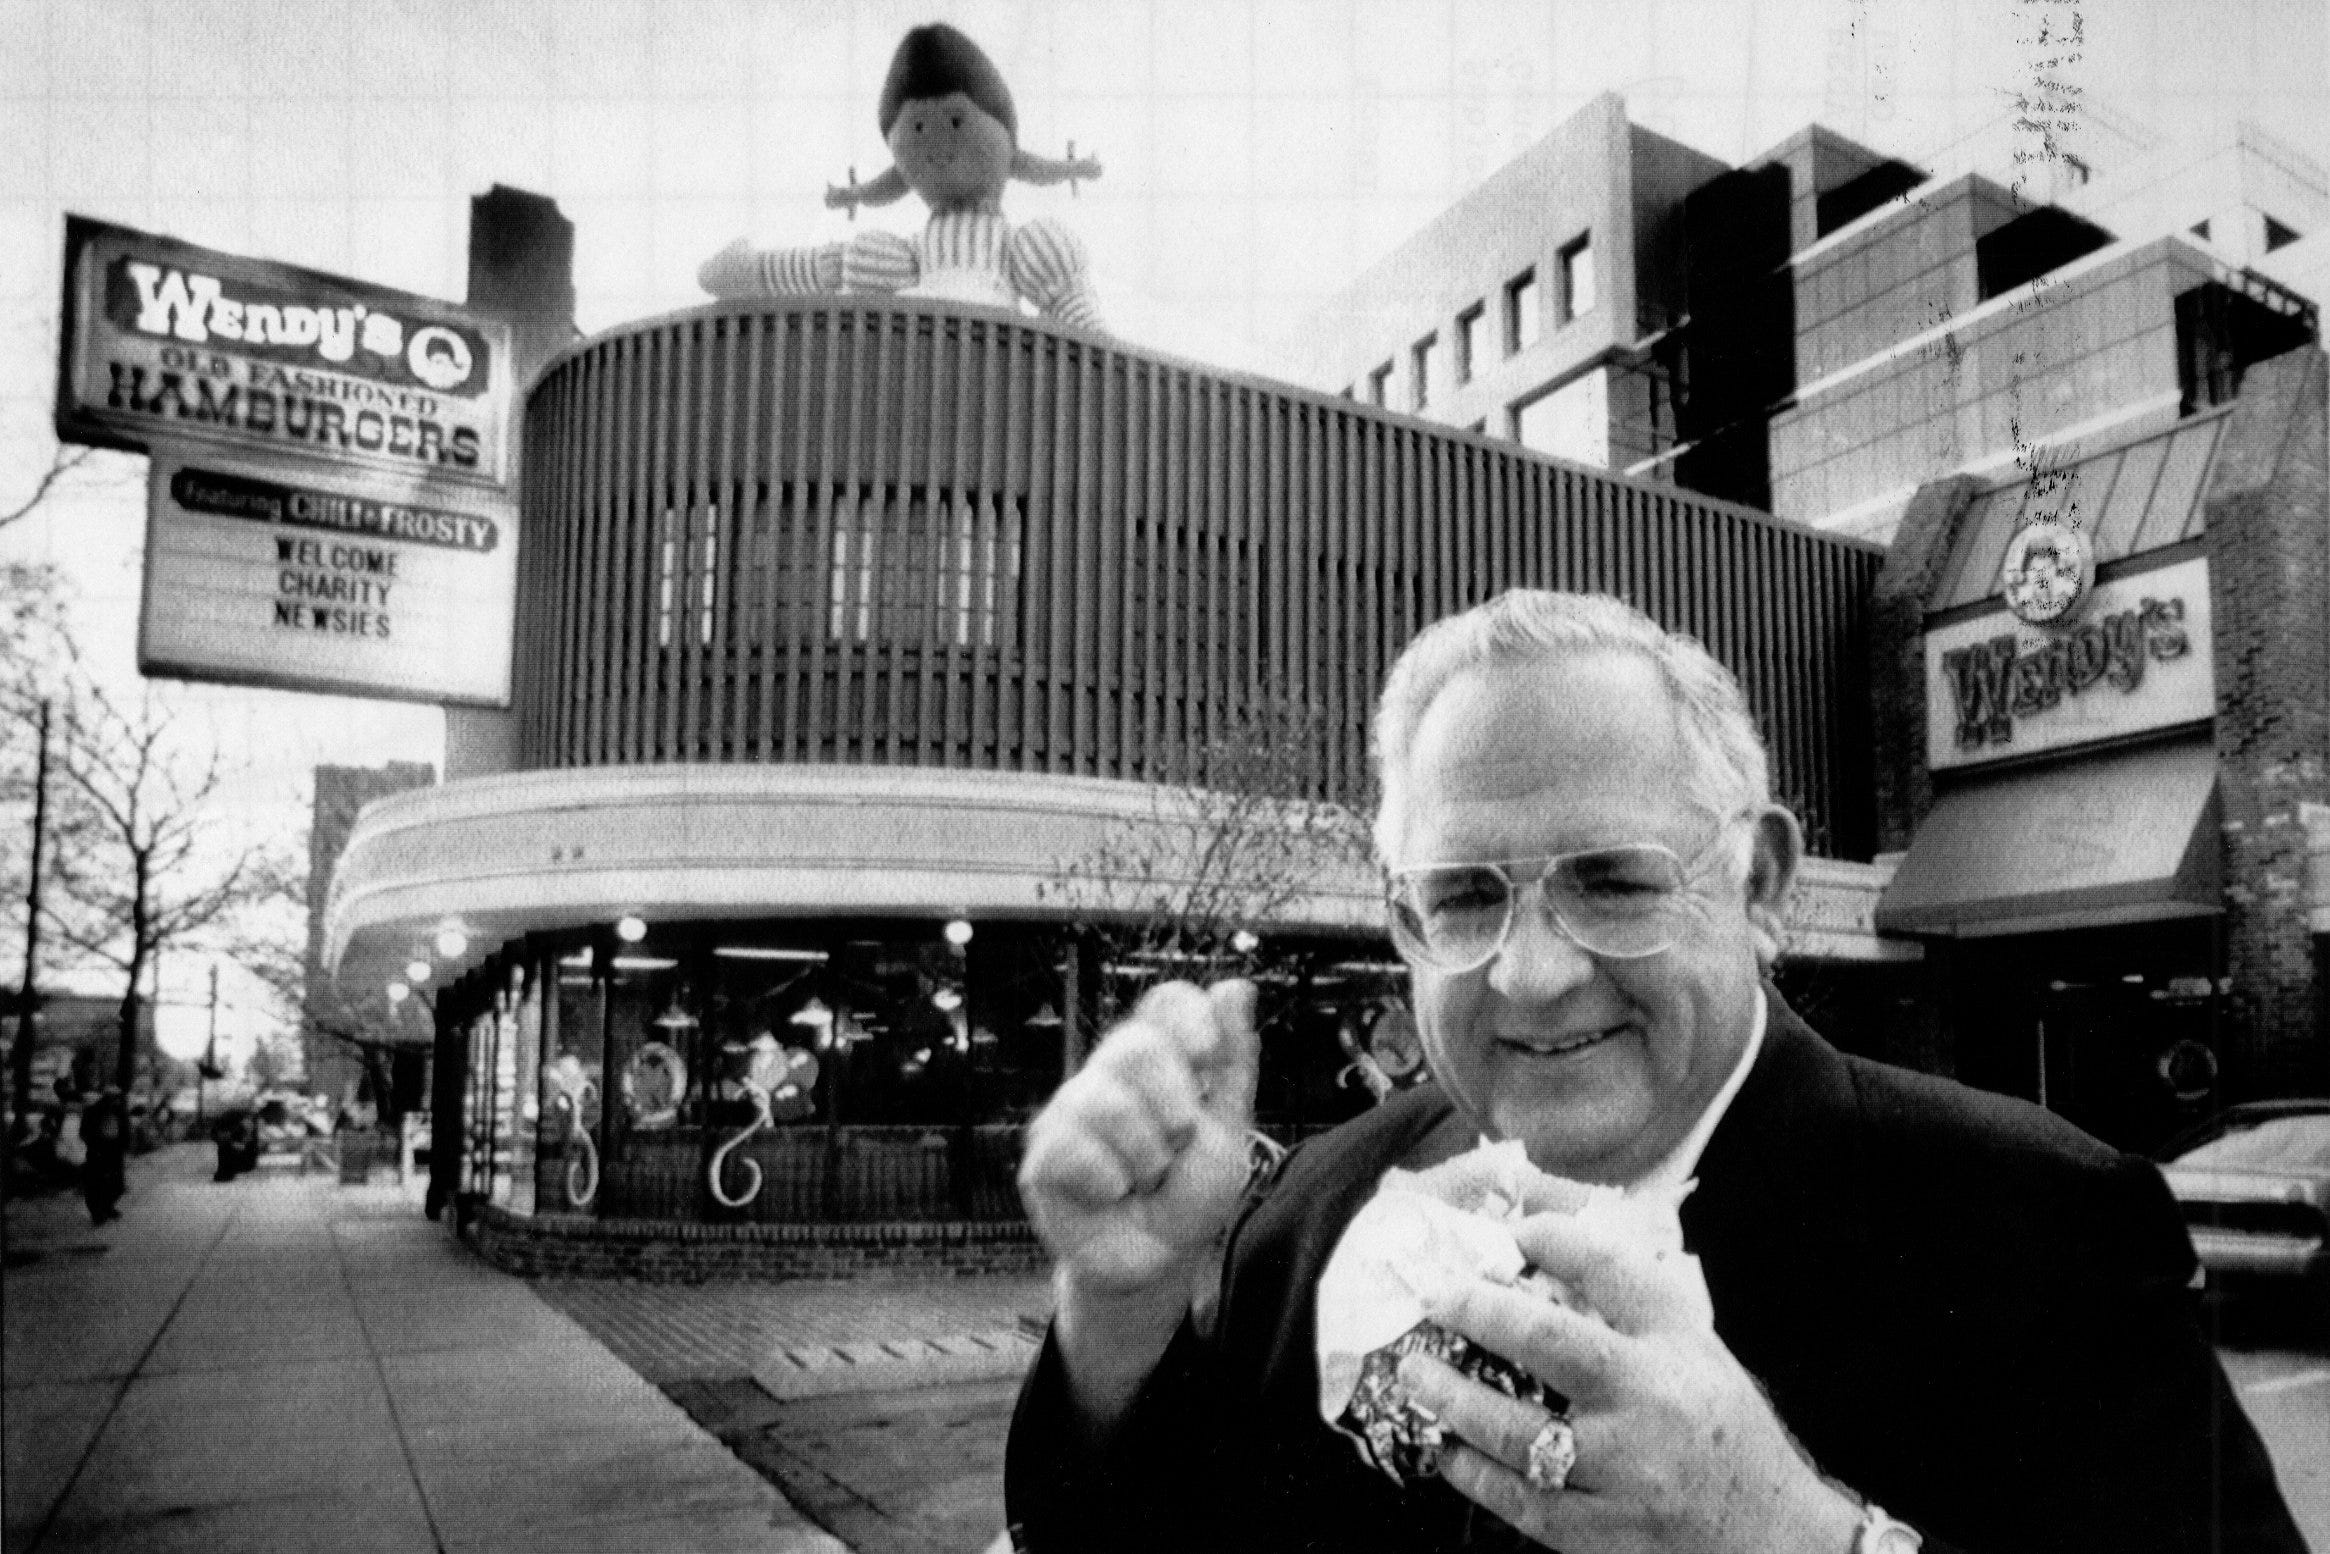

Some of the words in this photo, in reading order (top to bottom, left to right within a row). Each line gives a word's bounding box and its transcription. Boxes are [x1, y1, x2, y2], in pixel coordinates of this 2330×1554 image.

[128, 262, 402, 361] Wendy's
[248, 362, 440, 416] FASHIONED
[107, 362, 481, 467] HAMBURGERS
[378, 506, 489, 548] FROSTY
[274, 535, 400, 577] WELCOME
[279, 569, 392, 605] CHARITY
[274, 600, 392, 638] NEWSIES
